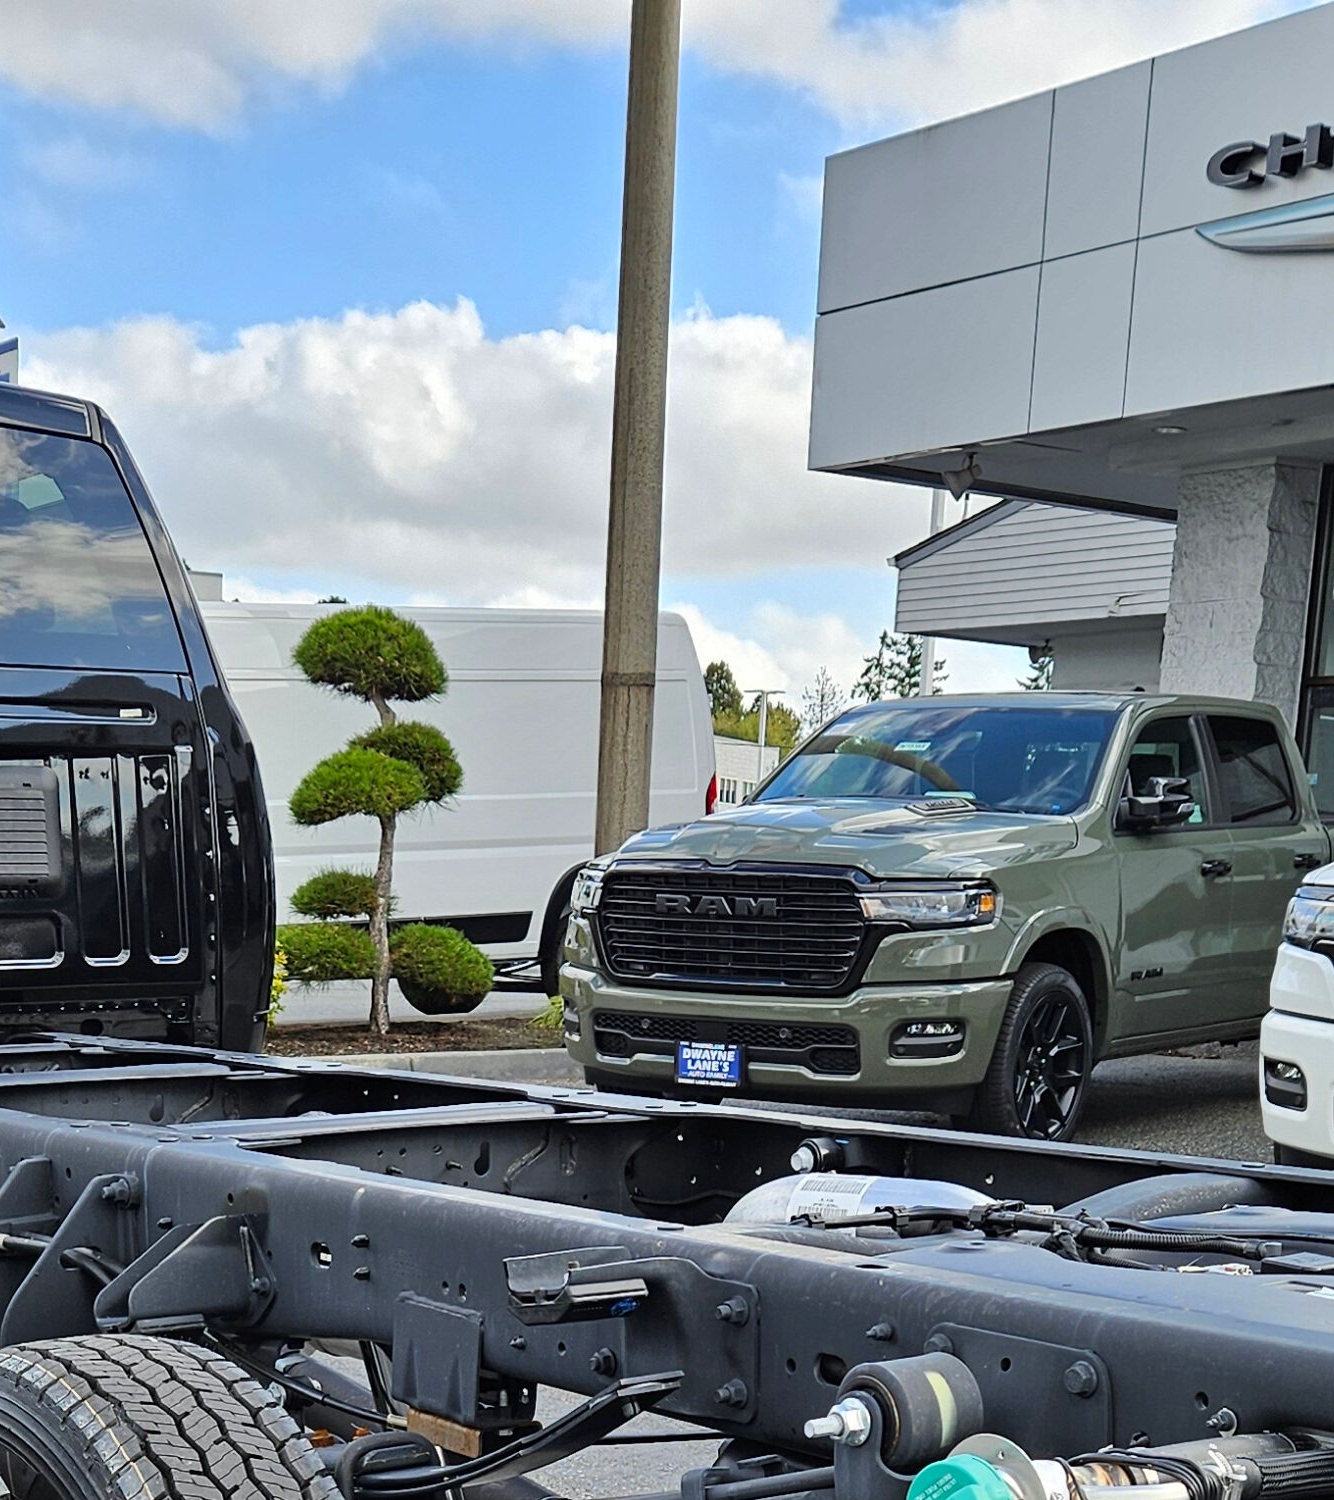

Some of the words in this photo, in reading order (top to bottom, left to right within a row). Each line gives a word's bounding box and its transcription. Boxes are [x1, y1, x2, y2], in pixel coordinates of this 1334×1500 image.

[655, 894, 777, 917] RAM
[682, 1047, 735, 1061] DWAYNE
[687, 1059, 730, 1073] LANE'S
